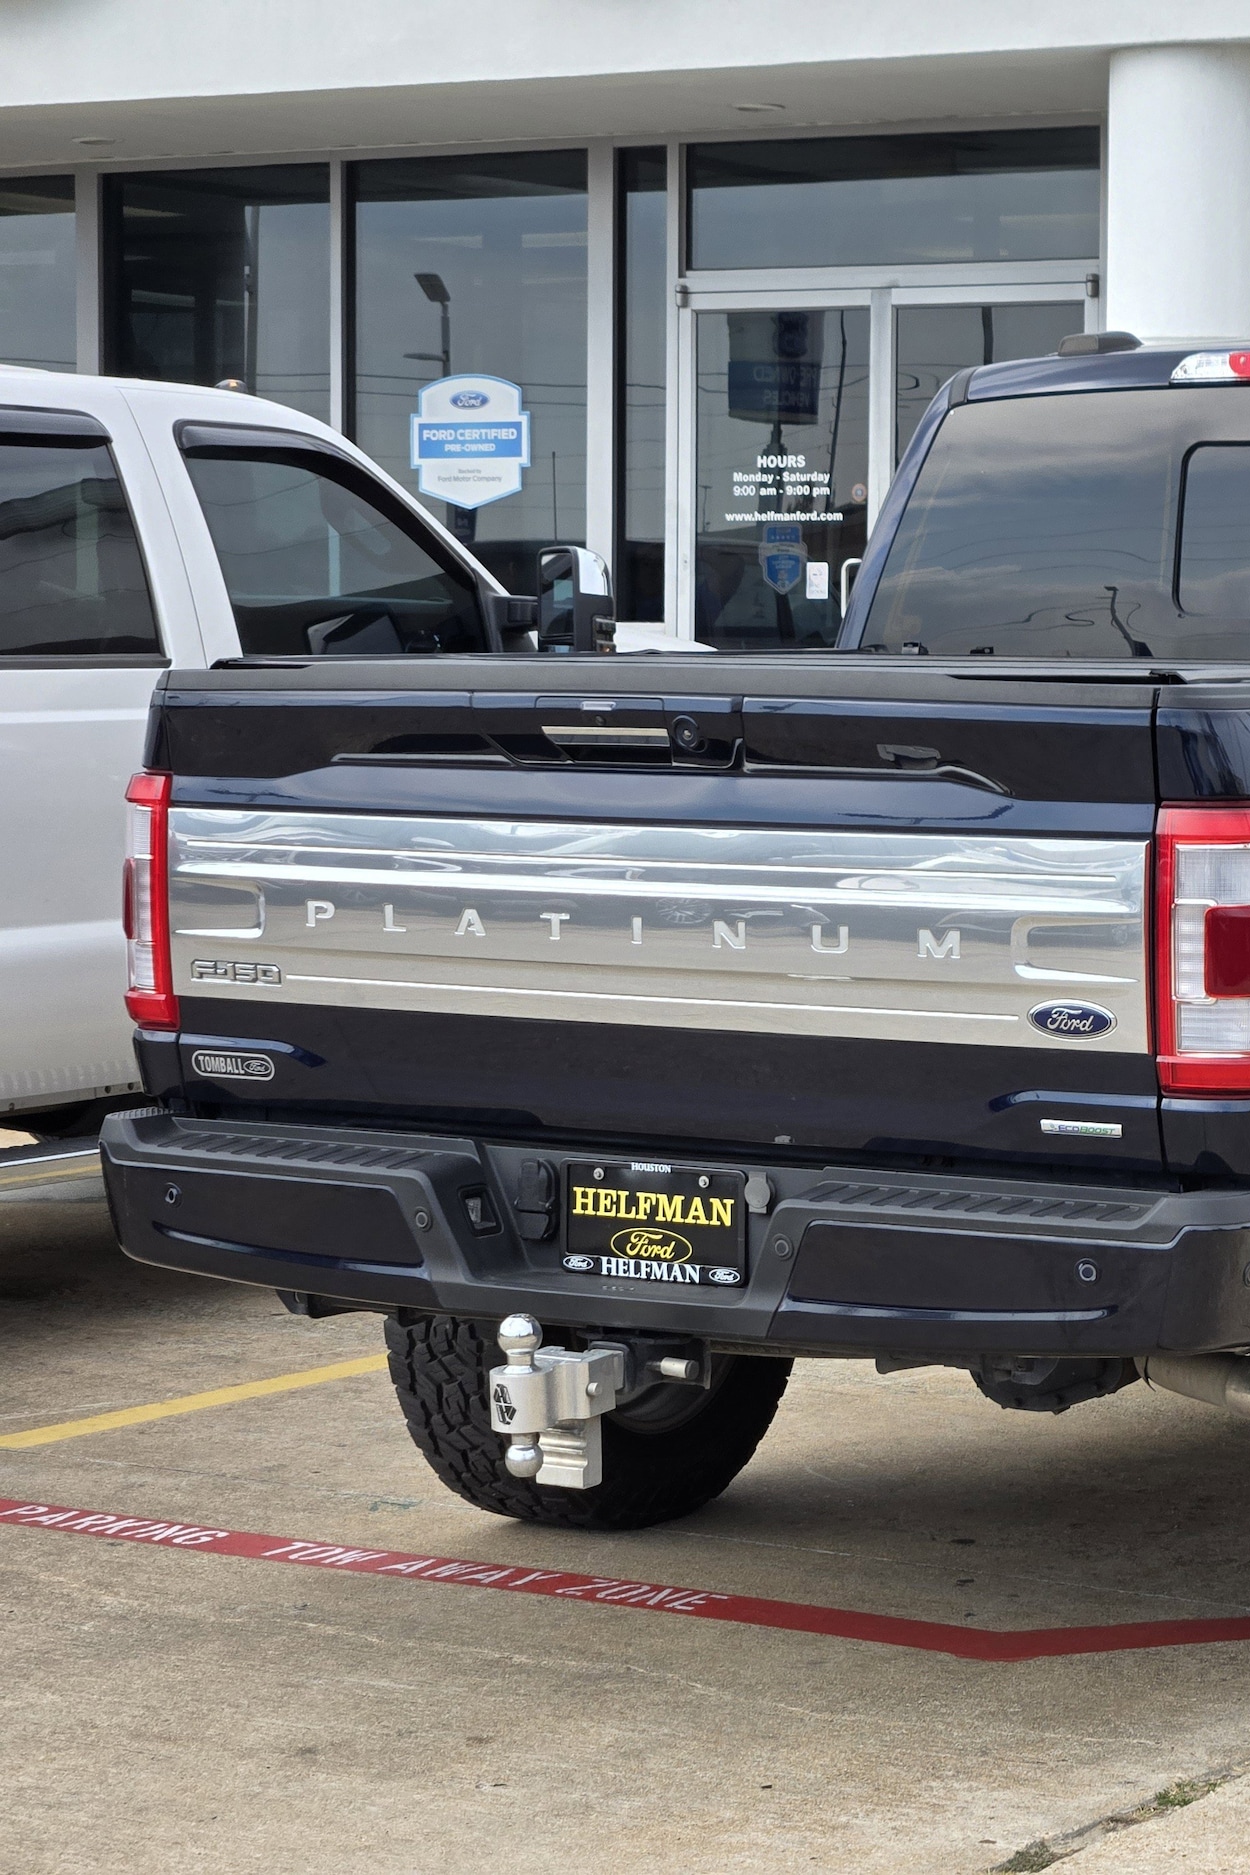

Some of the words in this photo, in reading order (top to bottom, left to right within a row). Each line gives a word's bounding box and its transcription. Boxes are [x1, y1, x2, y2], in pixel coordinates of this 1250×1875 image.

[422, 429, 455, 441] FORD
[457, 428, 518, 441] CERTIFIED
[444, 443, 496, 452] PRE-OWNED
[757, 455, 806, 468] HOURS
[473, 475, 503, 483] Company
[733, 472, 774, 484] Monday
[782, 471, 831, 484] Saturday
[733, 485, 756, 496] 9:00
[759, 487, 777, 496] am
[786, 485, 811, 496] 9:00
[812, 487, 831, 497] pm
[725, 511, 844, 521] www.helfmanford.com
[305, 899, 962, 960] PLATINUM
[191, 959, 282, 987] F-150
[1046, 1008, 1095, 1036] Ford
[198, 1055, 245, 1074] TOMBALL
[1058, 1124, 1115, 1135] ECOBOOST
[631, 1161, 671, 1174] HOUSTON
[572, 1186, 735, 1227] HELFMAN
[626, 1231, 676, 1260] Ford
[600, 1255, 701, 1284] HELFMAN
[0, 1504, 230, 1545] PARKING
[261, 1541, 389, 1566] TOW
[378, 1558, 563, 1587] AWAY
[554, 1578, 729, 1611] ZONE
